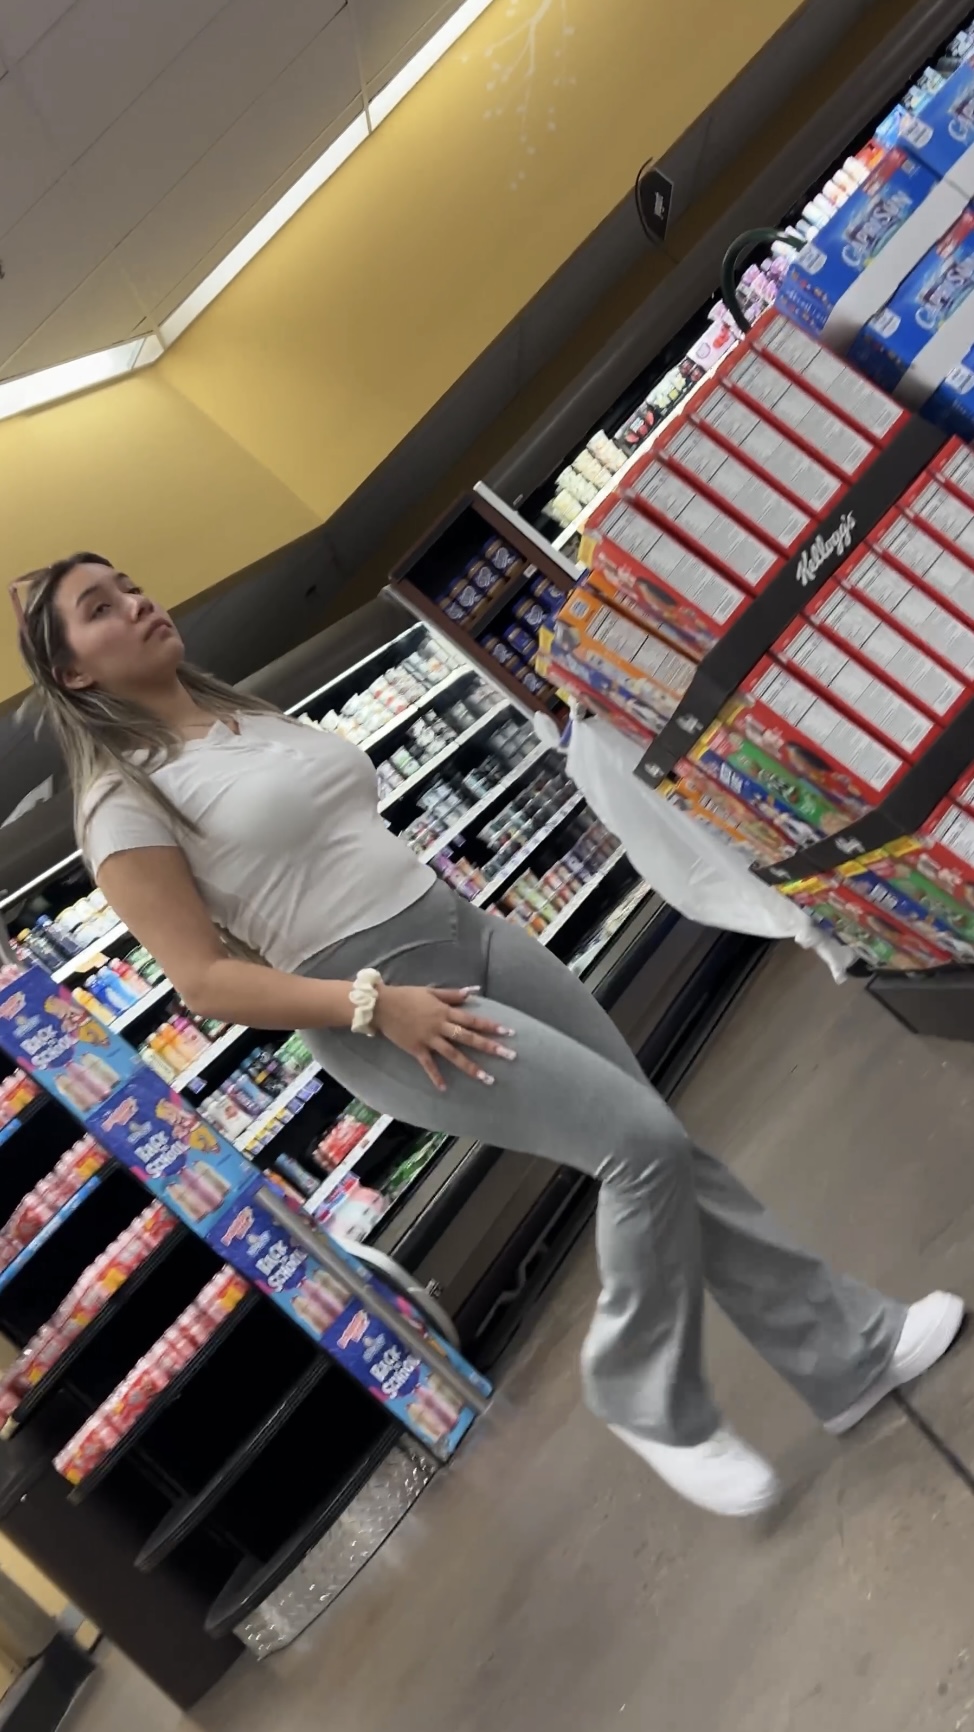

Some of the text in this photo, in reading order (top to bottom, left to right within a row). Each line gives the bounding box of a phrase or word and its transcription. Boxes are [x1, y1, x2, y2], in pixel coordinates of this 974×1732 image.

[796, 510, 856, 586] Kellogg's
[134, 1129, 169, 1162] BACK
[145, 1140, 190, 1178] SCHOOL
[370, 1345, 401, 1382] BACK
